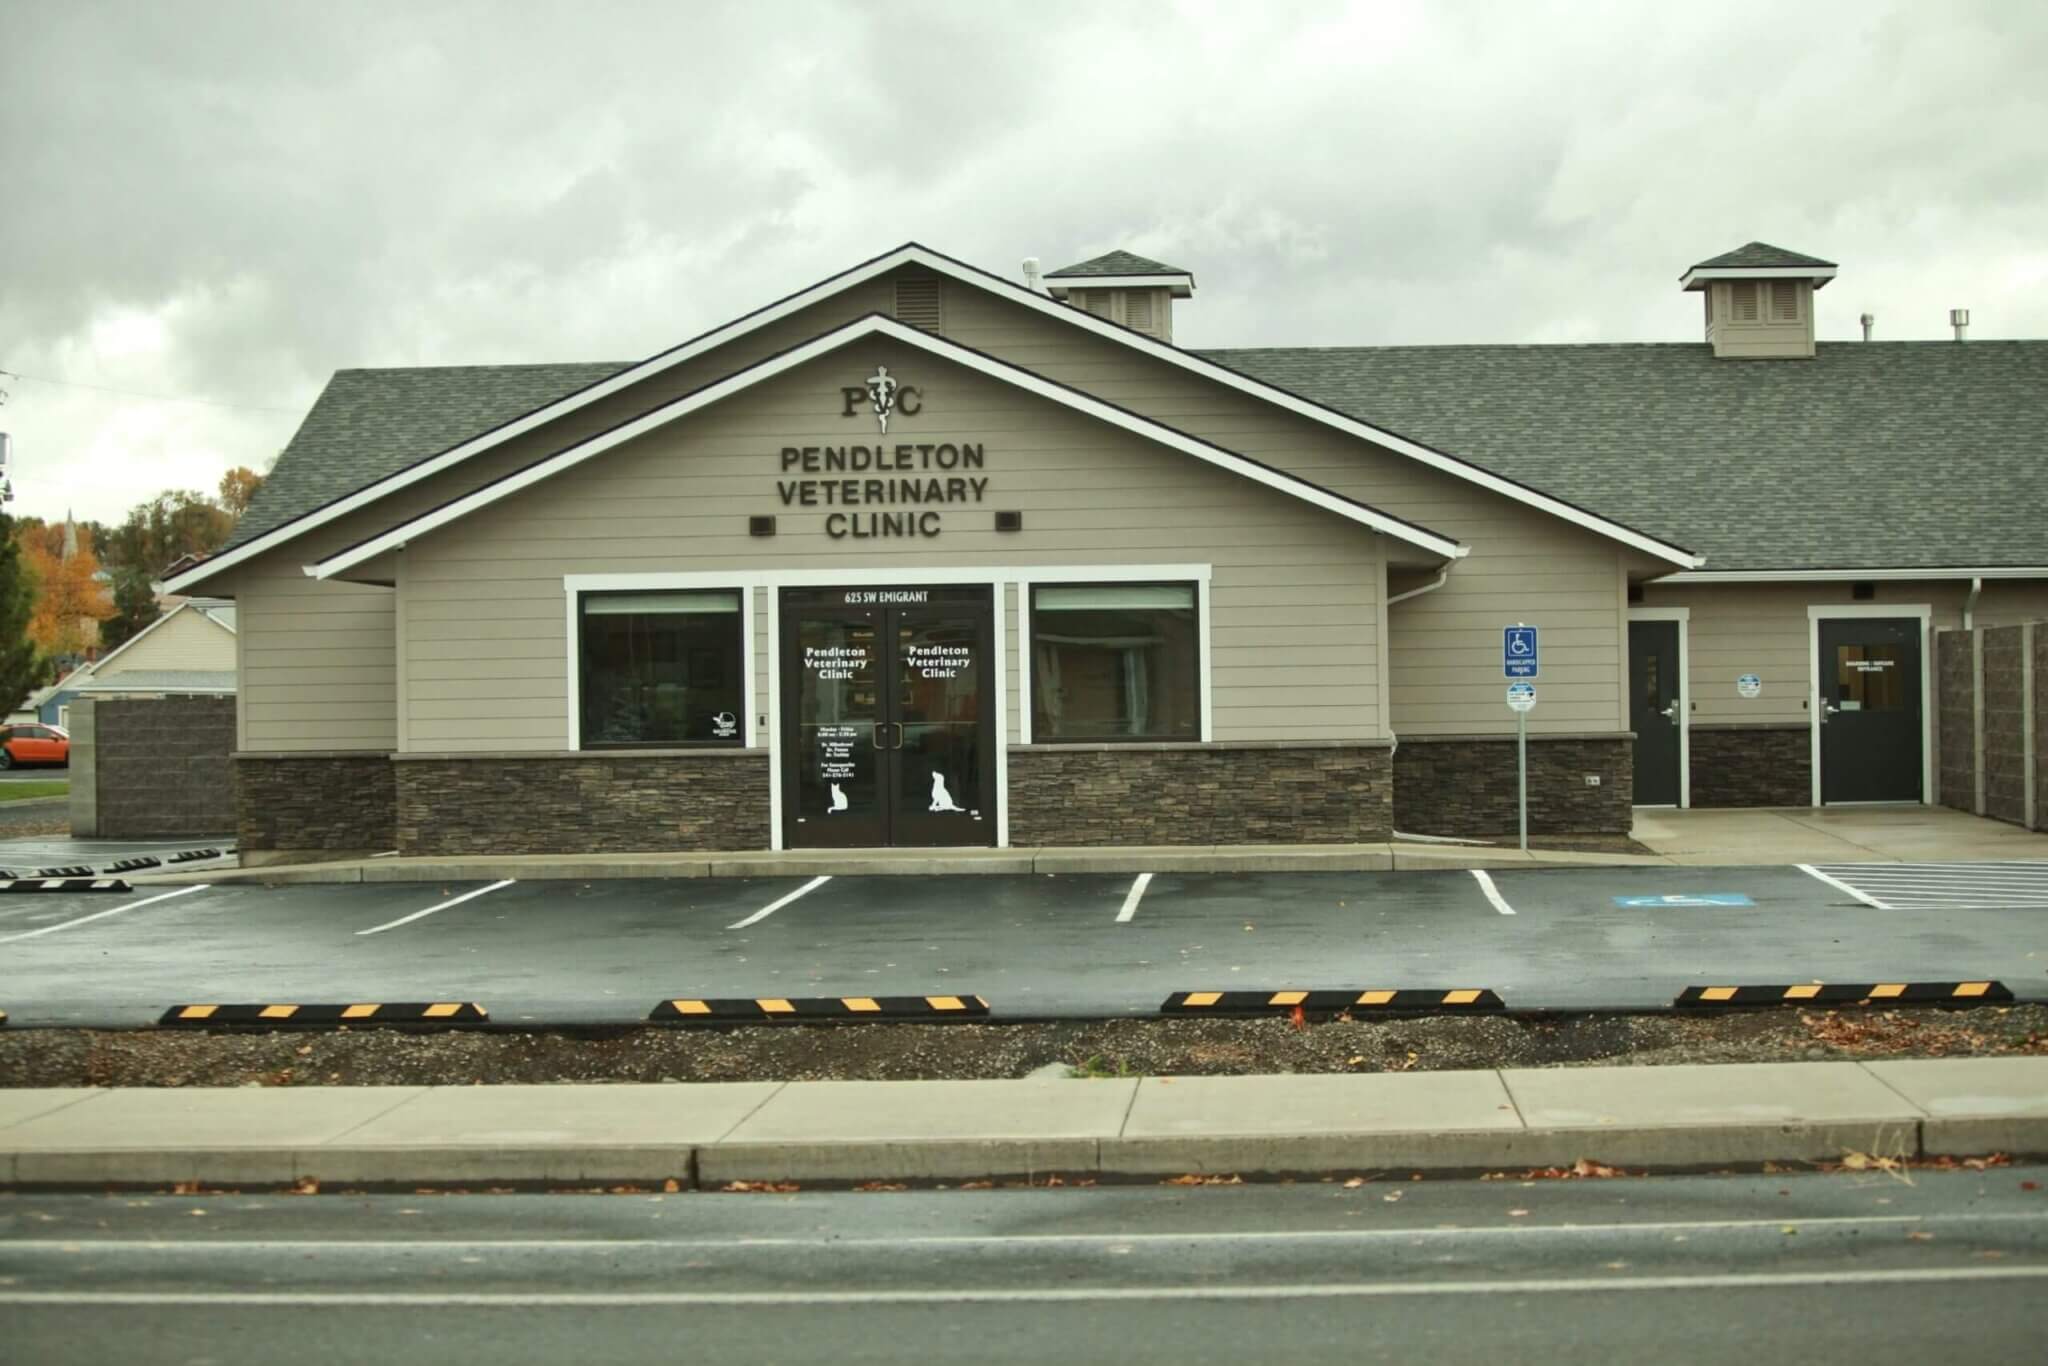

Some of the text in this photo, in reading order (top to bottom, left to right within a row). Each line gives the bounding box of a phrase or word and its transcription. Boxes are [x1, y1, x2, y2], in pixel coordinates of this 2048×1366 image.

[781, 444, 984, 472] PENDLETON
[777, 478, 989, 505] VETERINARY
[825, 511, 942, 538] CLINIC
[845, 591, 928, 603] 625 SW EMIGRANT
[806, 647, 866, 657] Pendleton
[909, 646, 969, 656] Pendleton
[804, 658, 867, 669] Veterinary
[907, 657, 970, 668] Veterinary
[819, 669, 854, 679] Clinic
[922, 668, 957, 678] Clinic
